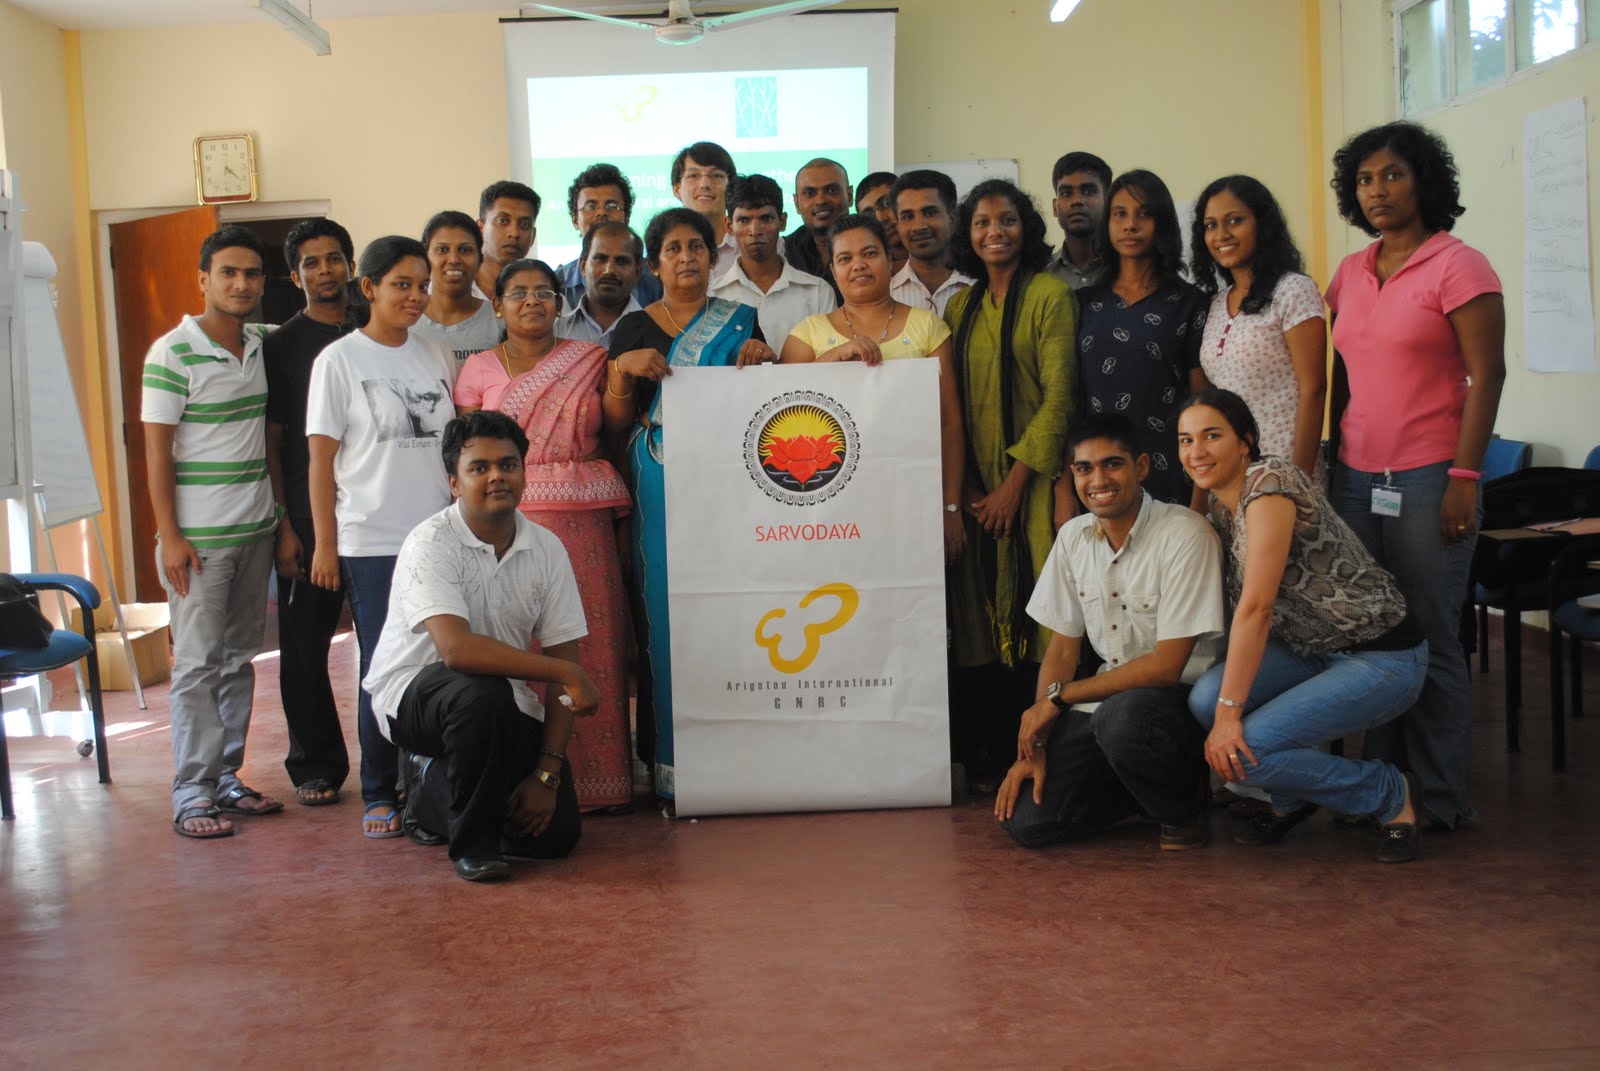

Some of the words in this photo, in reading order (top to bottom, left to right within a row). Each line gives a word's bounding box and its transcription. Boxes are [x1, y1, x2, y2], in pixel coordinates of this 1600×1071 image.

[755, 522, 861, 542] SARVODAYA
[726, 681, 787, 692] Arigatou
[797, 677, 893, 689] International
